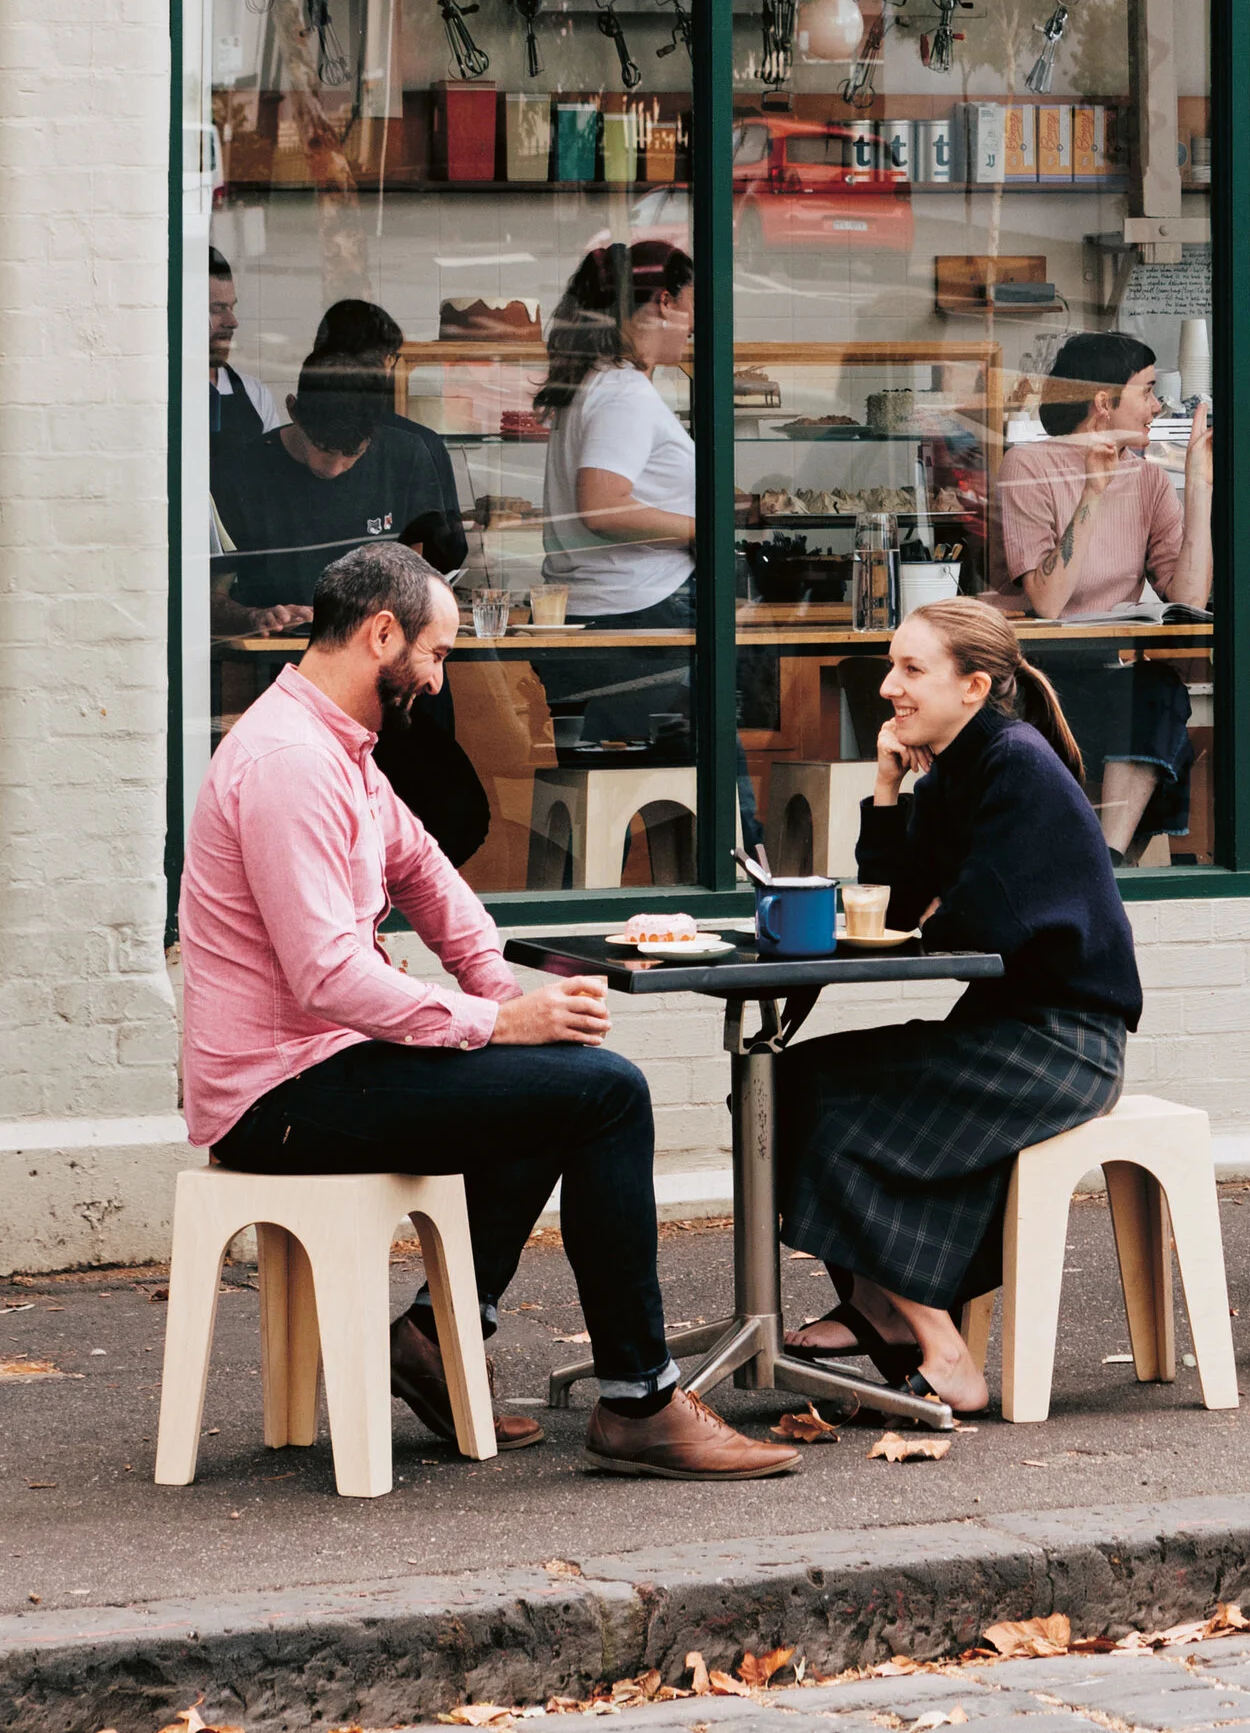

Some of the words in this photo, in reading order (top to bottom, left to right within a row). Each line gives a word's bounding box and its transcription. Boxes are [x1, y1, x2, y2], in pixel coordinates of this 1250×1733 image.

[853, 134, 871, 167] t
[890, 134, 908, 167] t
[933, 134, 950, 167] t
